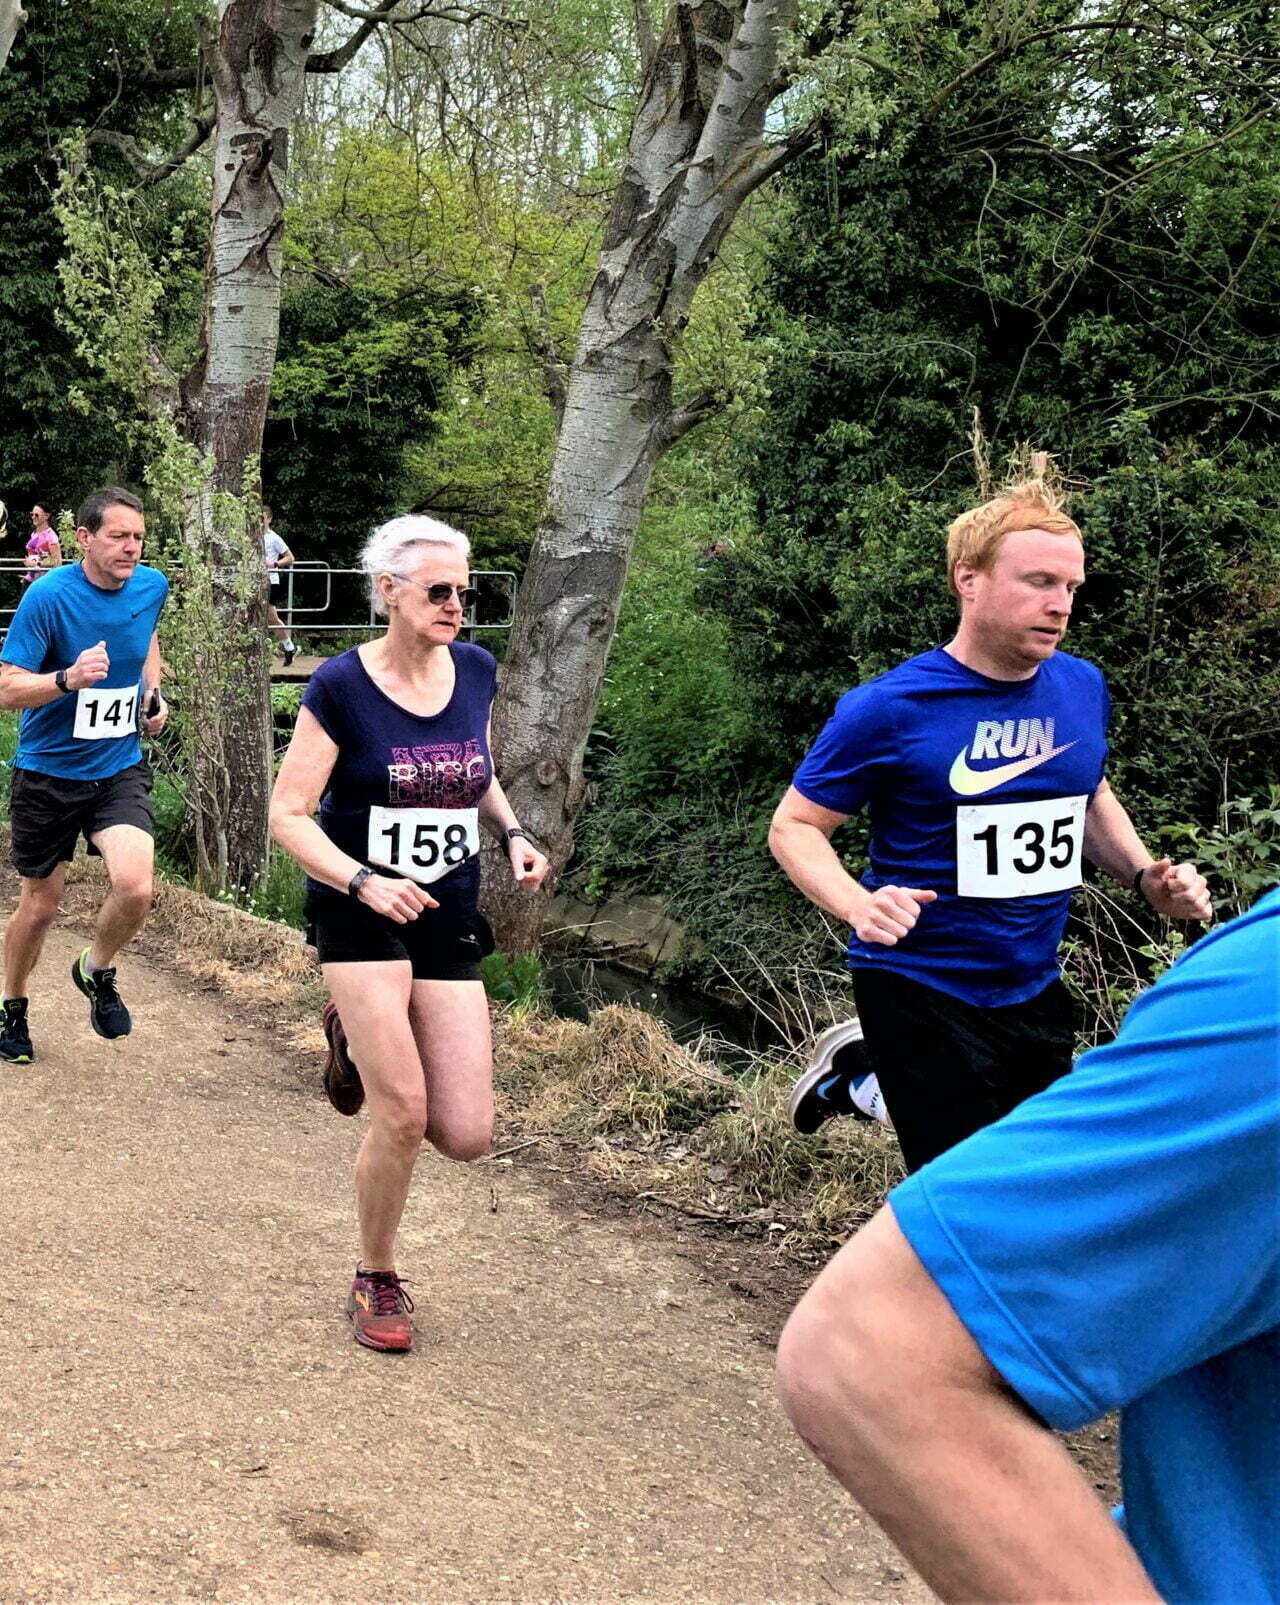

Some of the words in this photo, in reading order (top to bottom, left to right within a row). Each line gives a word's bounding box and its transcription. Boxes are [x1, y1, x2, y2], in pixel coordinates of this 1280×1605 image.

[85, 695, 135, 728] 141
[970, 716, 1056, 760] RUN
[381, 822, 471, 868] 158
[973, 815, 1075, 876] 135
